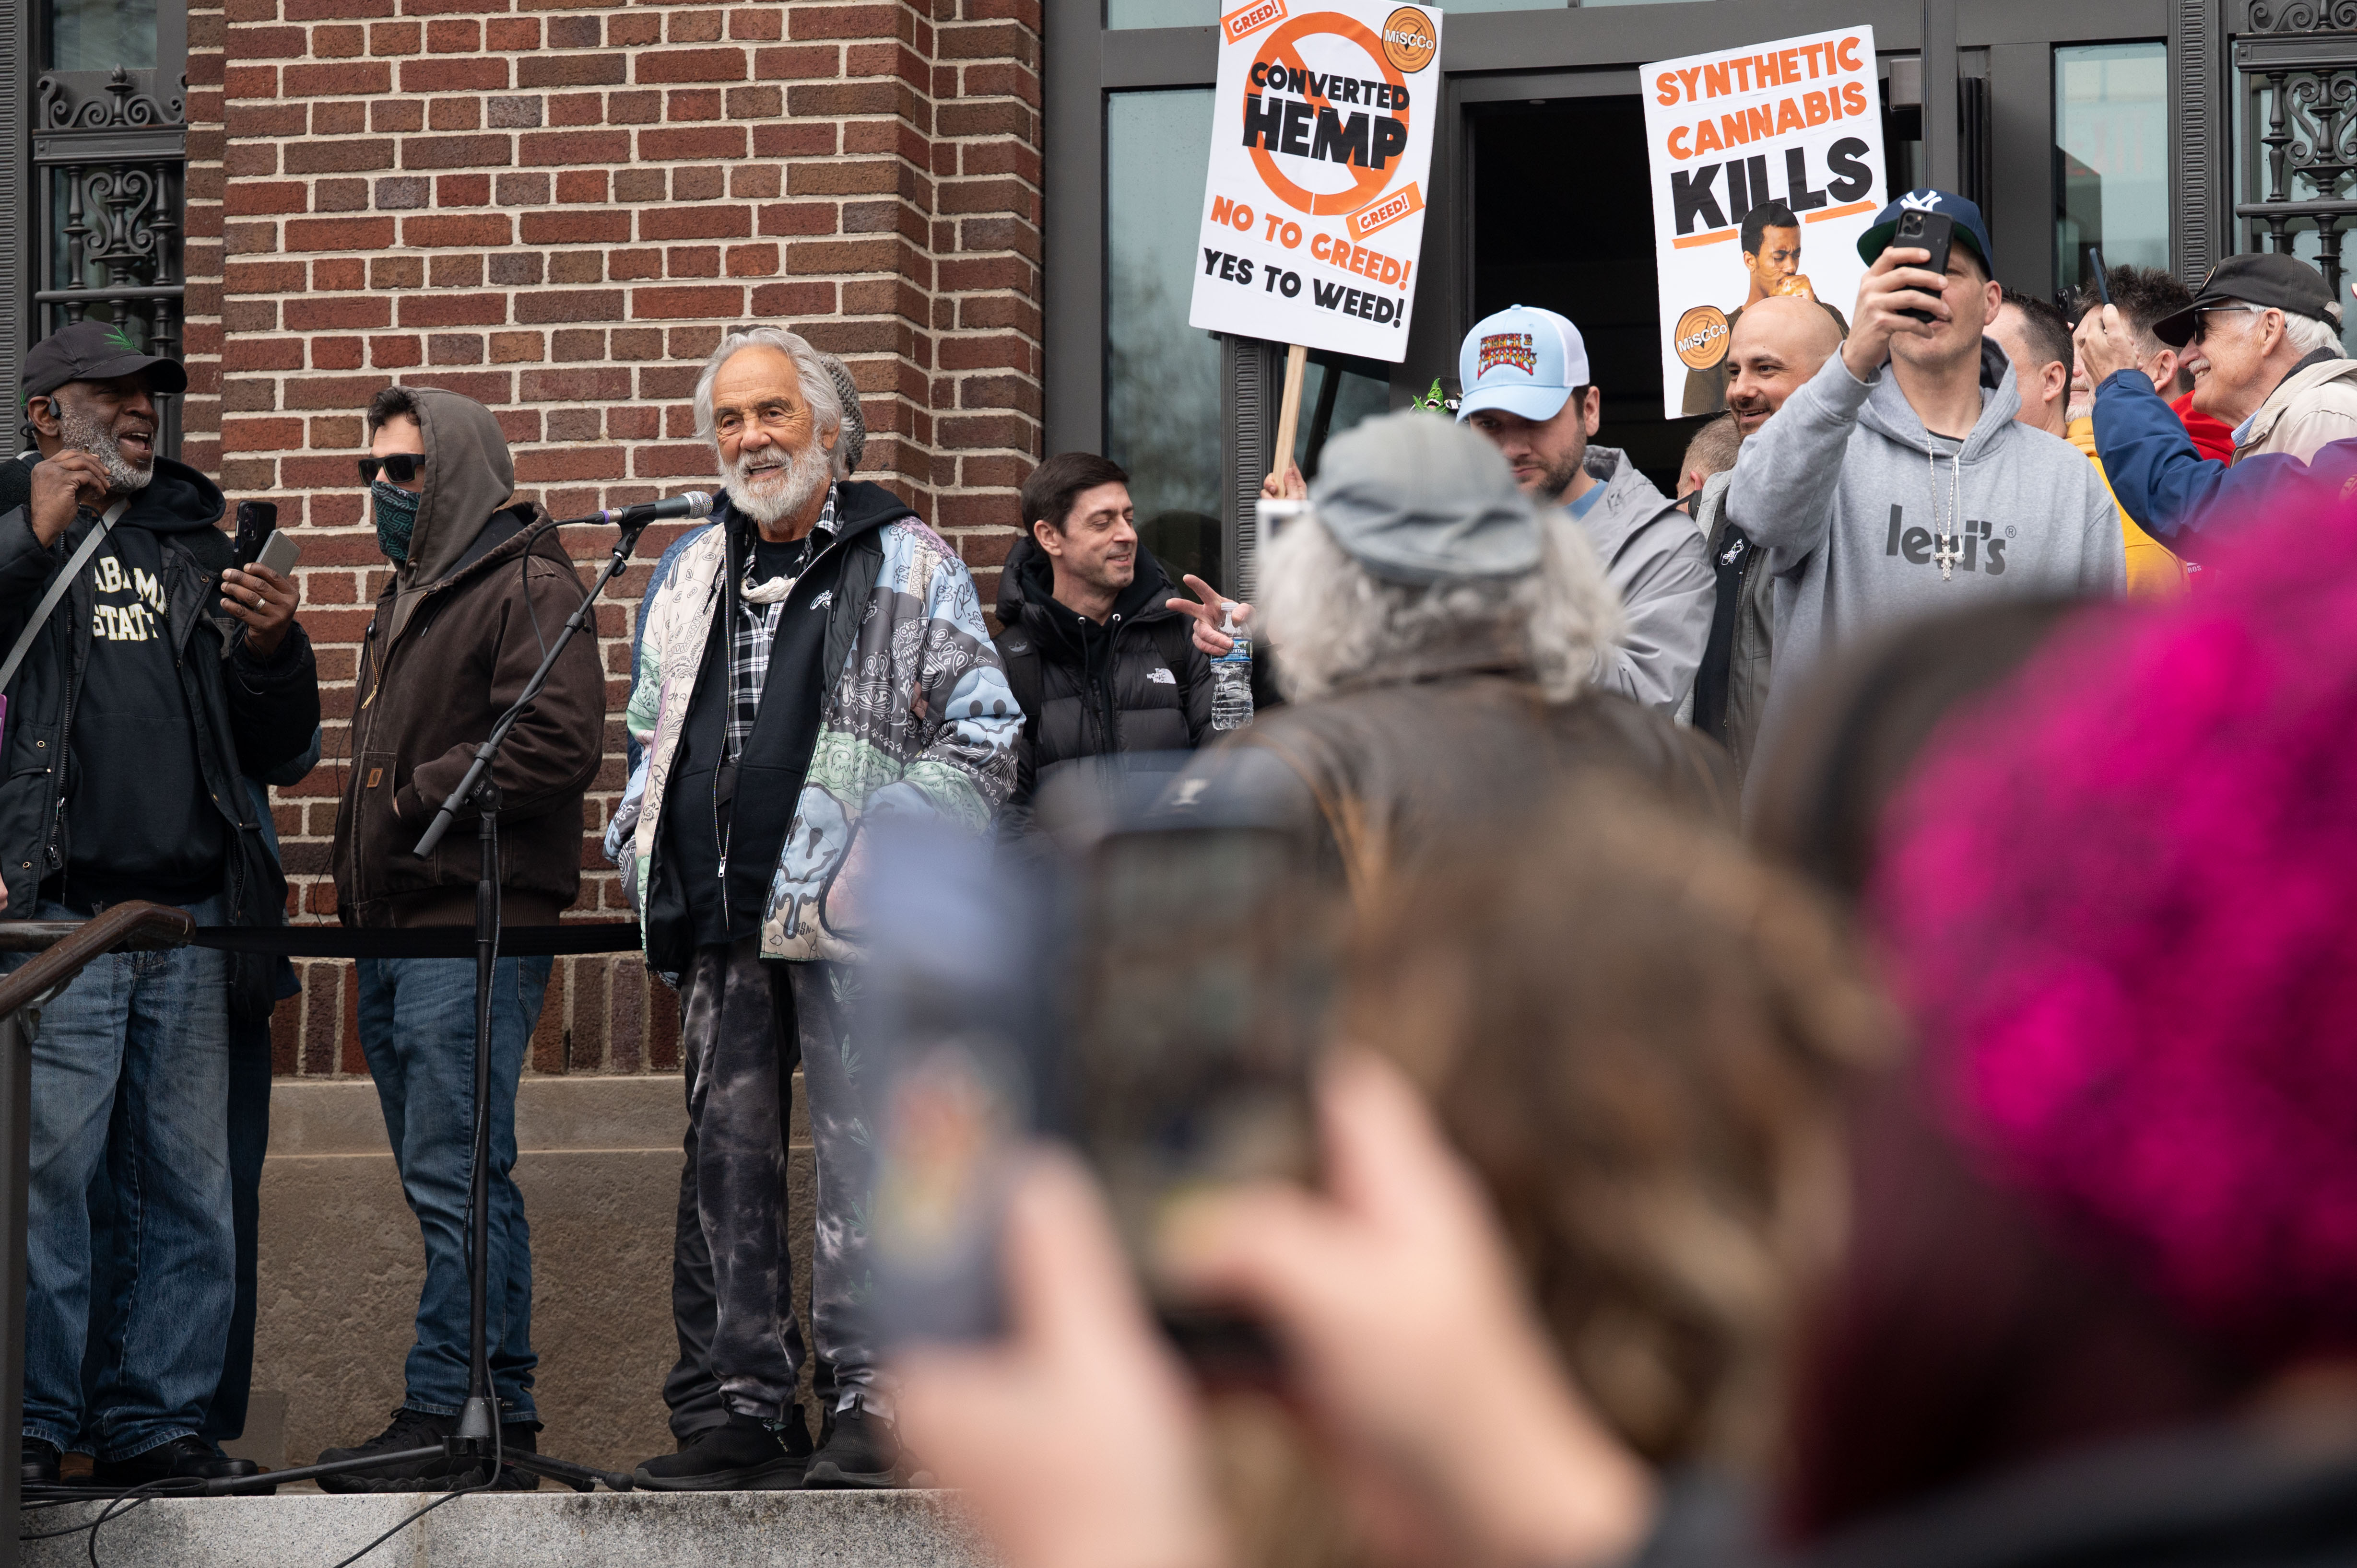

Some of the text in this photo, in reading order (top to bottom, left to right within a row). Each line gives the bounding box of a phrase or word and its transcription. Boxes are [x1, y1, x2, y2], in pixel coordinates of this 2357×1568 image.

[1232, 0, 1278, 33] GREED!
[1250, 61, 1410, 111] CONVERTED
[1656, 36, 1864, 106] SYNTHETIC
[1242, 93, 1408, 170] HEMP
[1667, 81, 1867, 160] CANNABIS
[1360, 196, 1408, 230] GREED!
[1671, 137, 1874, 235] KILLS
[1210, 195, 1413, 291] NO TO GREED!
[1203, 247, 1405, 328] YES TO WEED!
